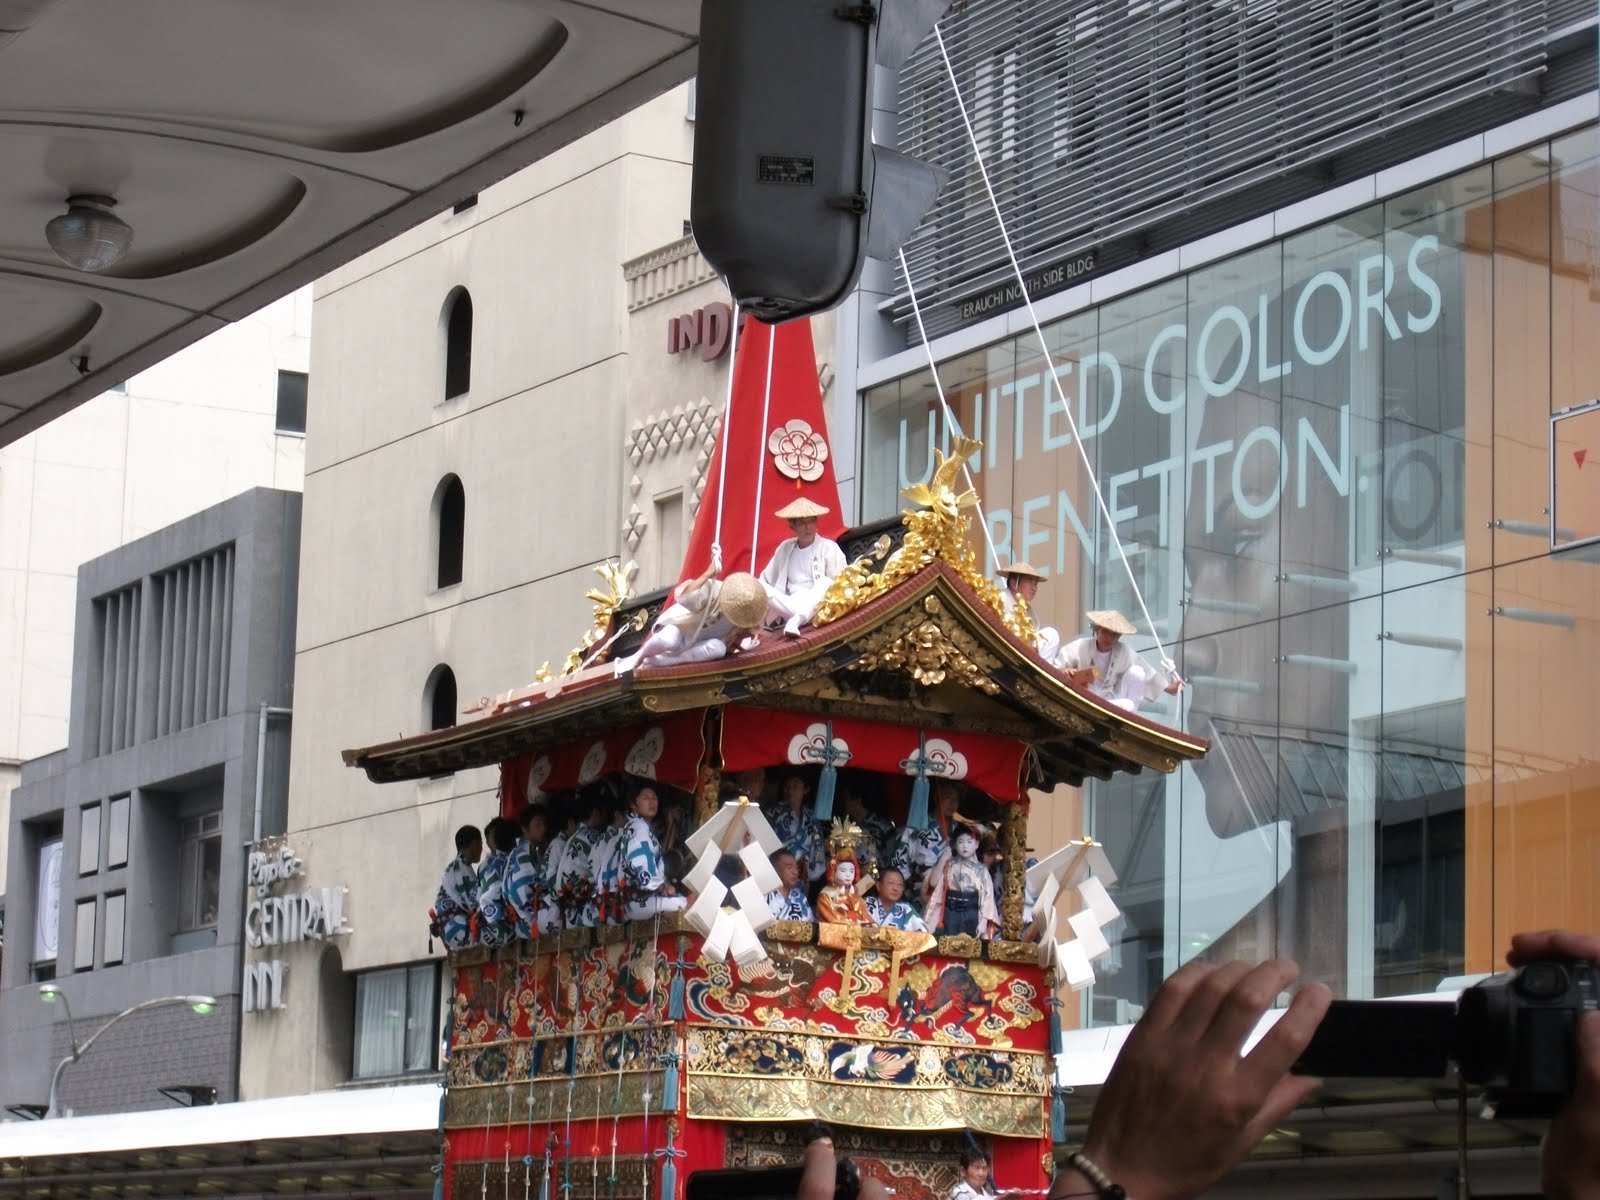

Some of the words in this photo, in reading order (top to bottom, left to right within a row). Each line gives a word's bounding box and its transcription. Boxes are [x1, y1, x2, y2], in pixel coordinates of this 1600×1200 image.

[1043, 269, 1064, 288] SIDE
[1067, 256, 1095, 278] BLDG.
[898, 351, 1122, 488] UNITED
[1144, 235, 1441, 414] COLORS
[245, 886, 353, 948] CENTRAL
[243, 959, 287, 1012] INN
